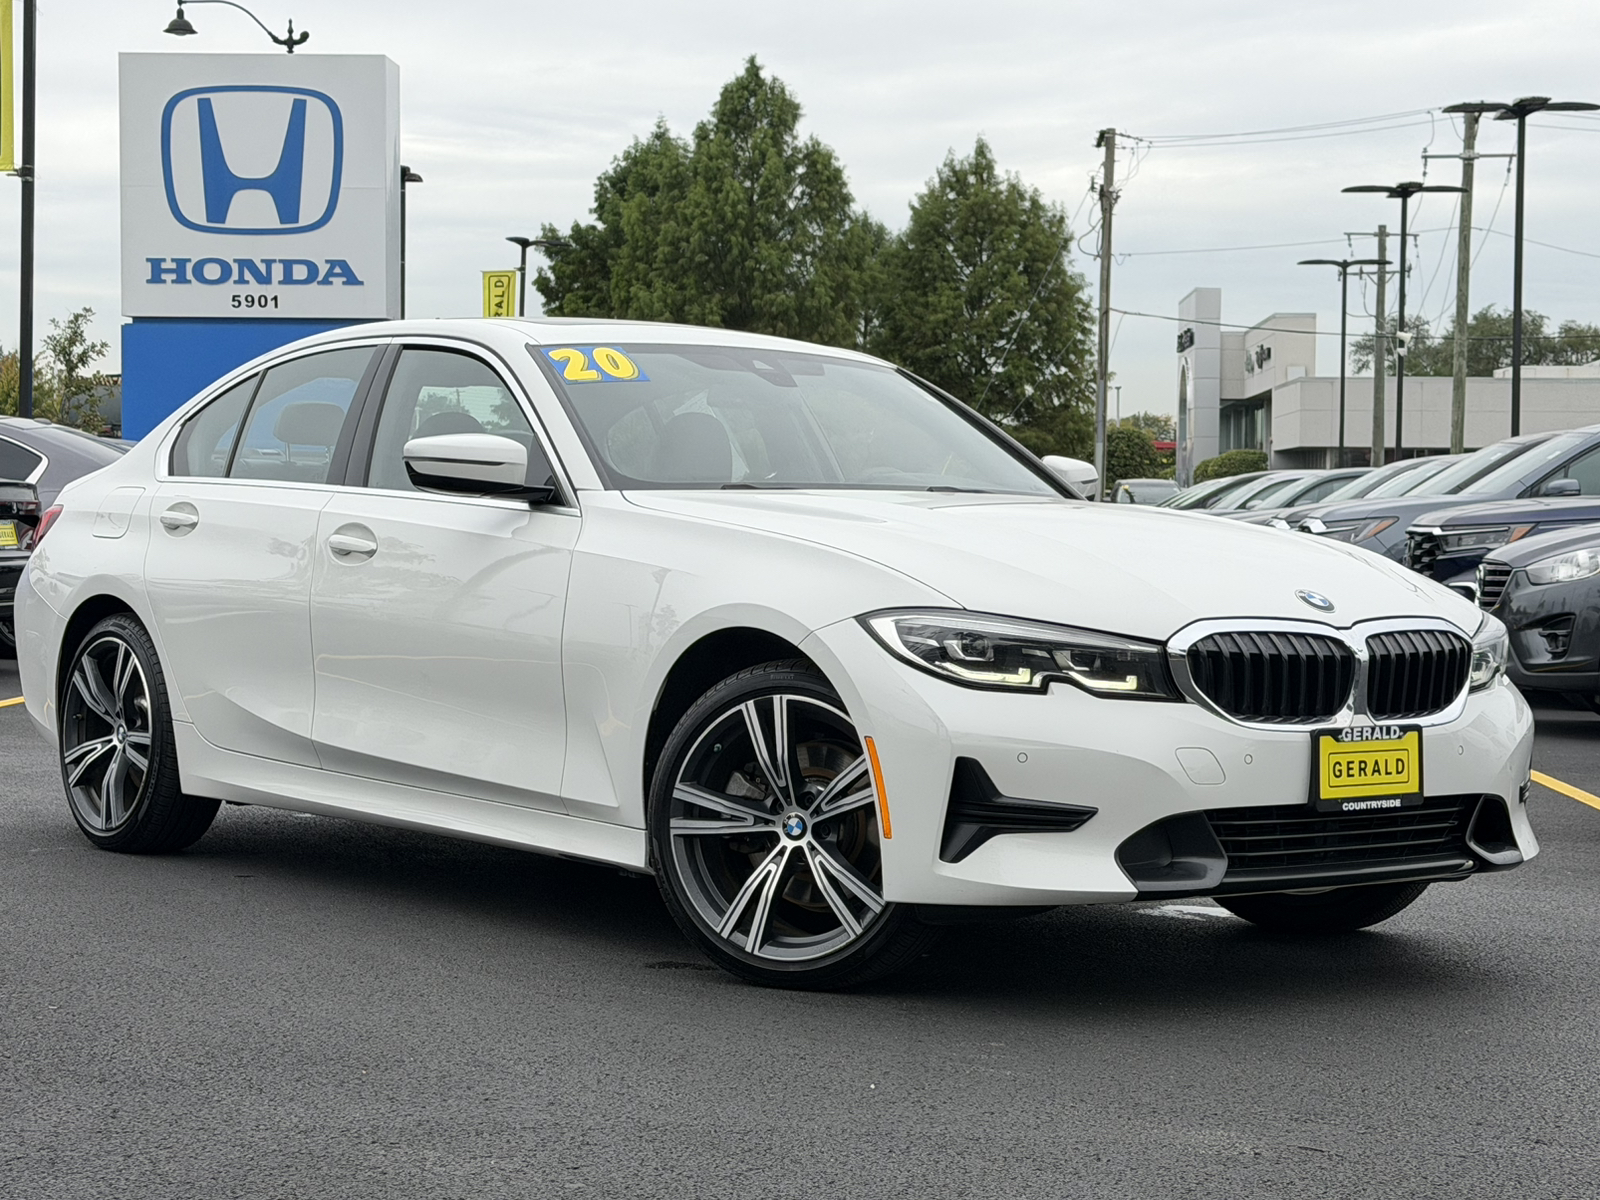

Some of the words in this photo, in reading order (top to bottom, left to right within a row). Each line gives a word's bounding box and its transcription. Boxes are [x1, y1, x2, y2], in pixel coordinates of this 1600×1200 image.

[146, 257, 364, 286] HONDA
[231, 294, 279, 309] 5901
[548, 347, 640, 382] 20
[1341, 725, 1401, 742] GERALD
[1332, 757, 1406, 779] GERALD
[1342, 799, 1402, 811] COUNTRYSIDE
